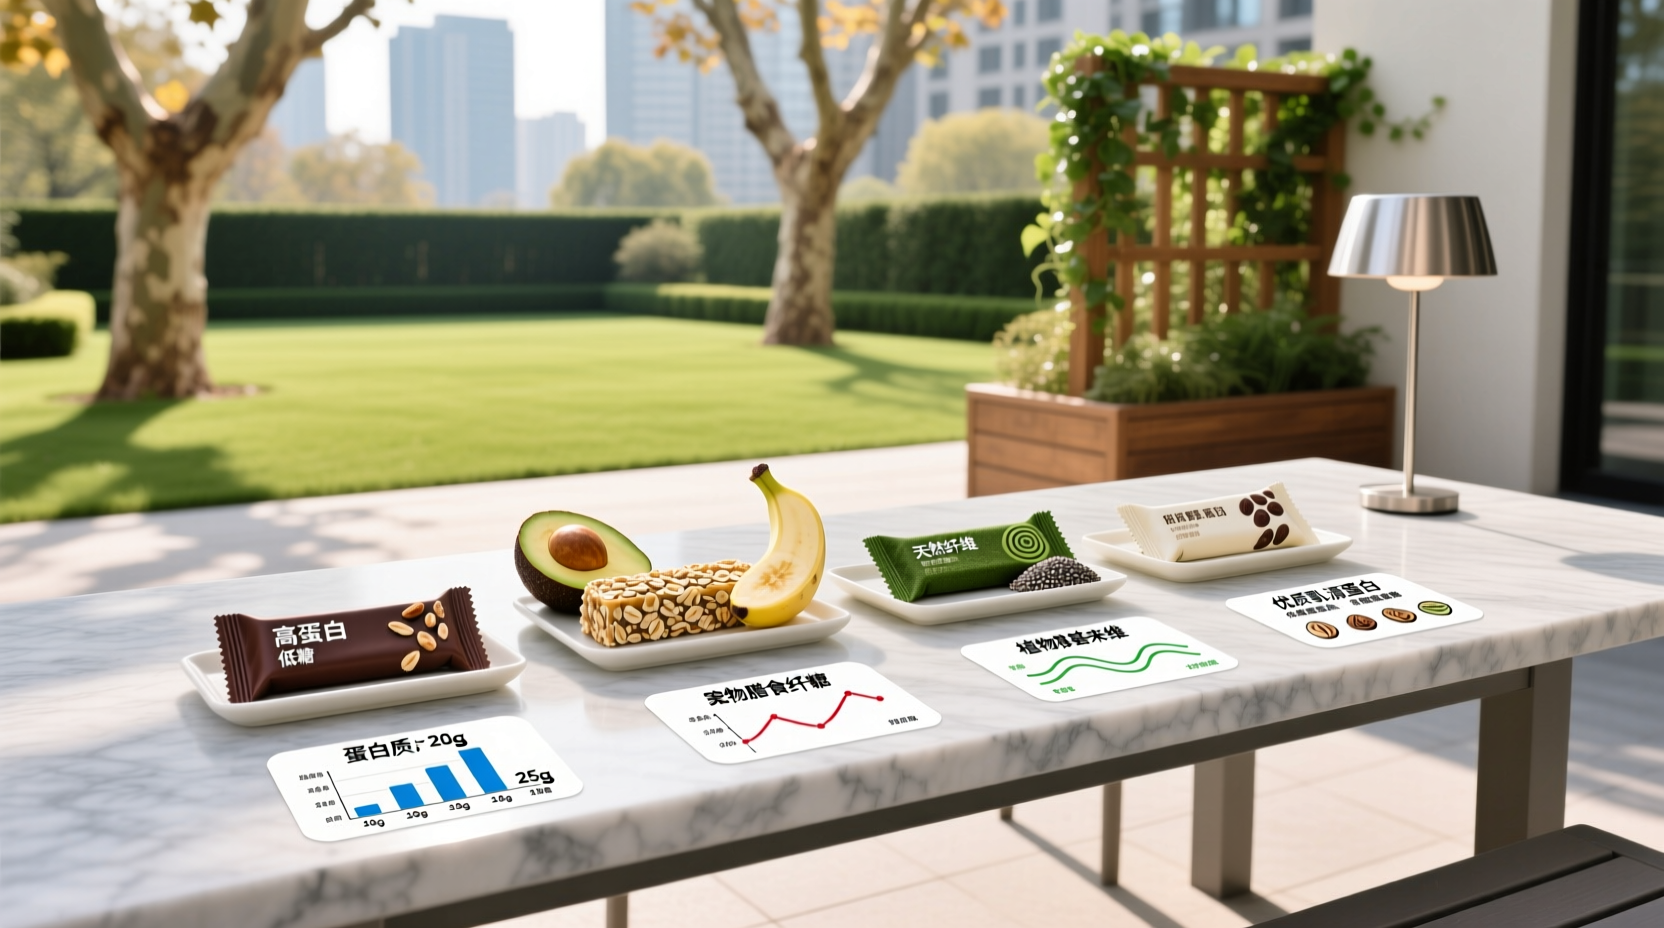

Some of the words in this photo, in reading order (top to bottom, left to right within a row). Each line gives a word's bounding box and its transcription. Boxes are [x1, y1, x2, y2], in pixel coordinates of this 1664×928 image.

[912, 536, 979, 560] 天然纤维
[272, 620, 347, 649] 高蛋白
[278, 647, 315, 669] 低糖
[515, 769, 555, 785] 25g
